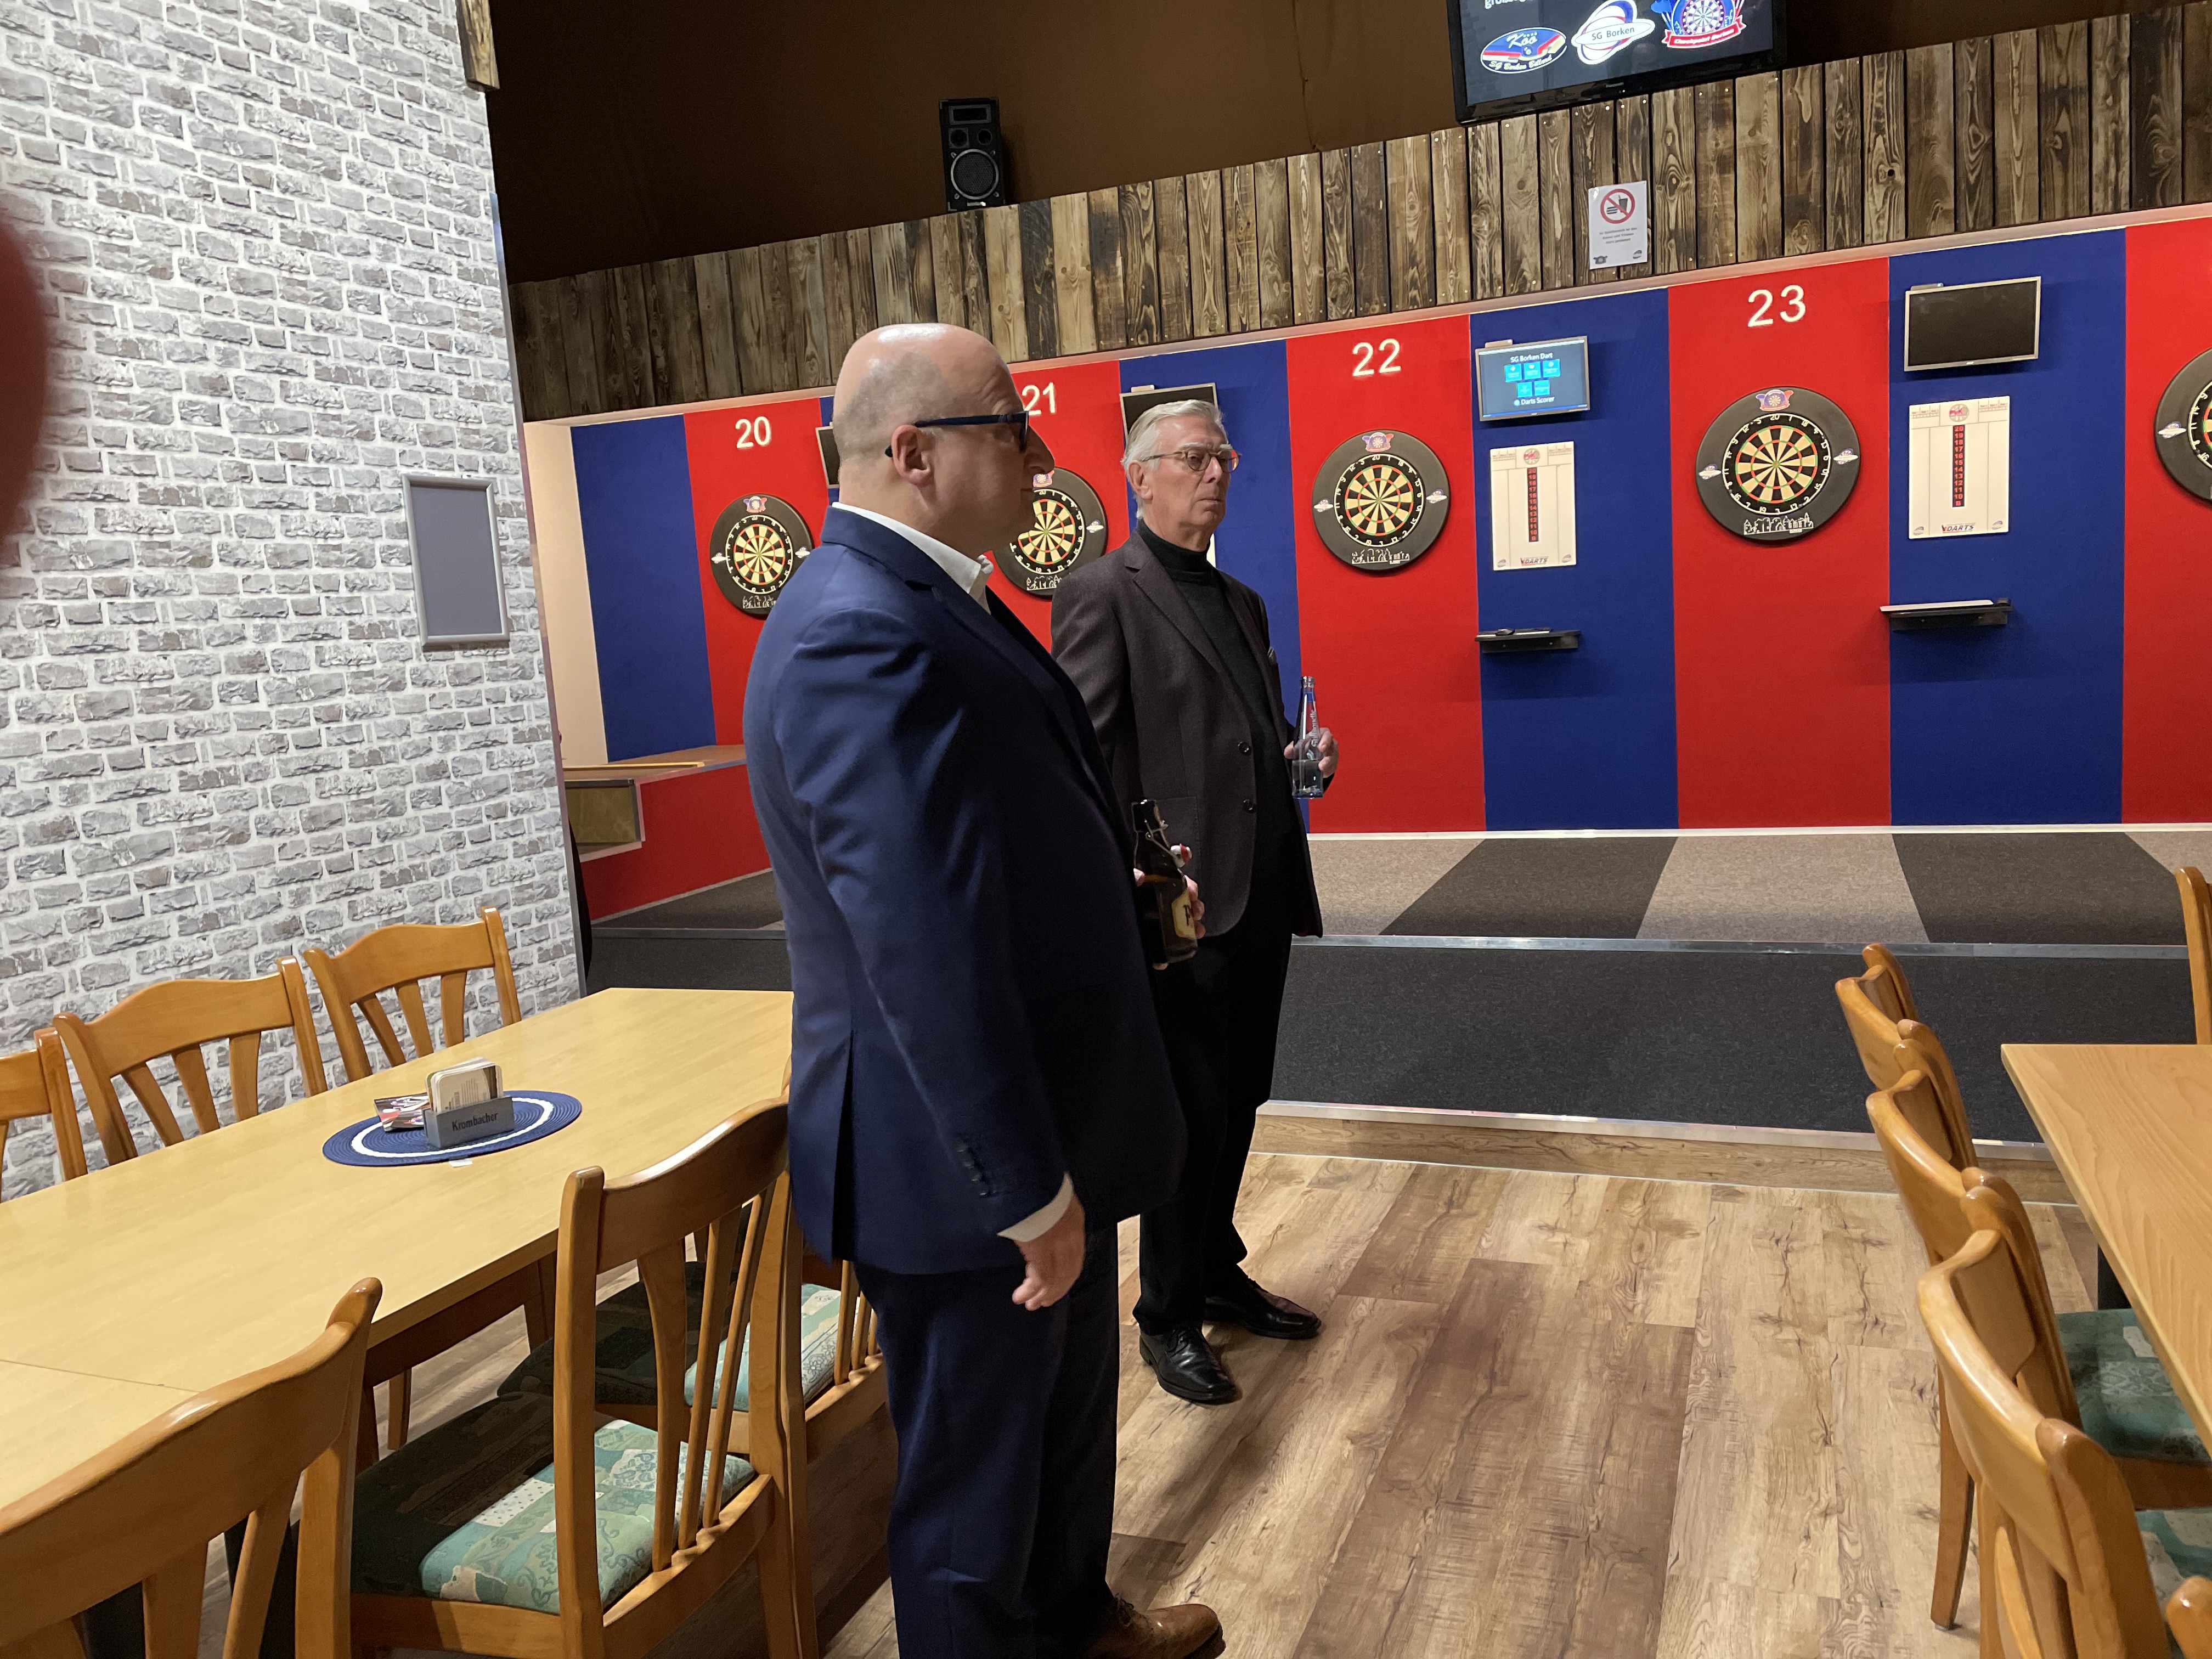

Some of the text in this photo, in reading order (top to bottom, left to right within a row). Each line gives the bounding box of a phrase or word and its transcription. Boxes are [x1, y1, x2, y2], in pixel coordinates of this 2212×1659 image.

[1592, 27, 1634, 41] SG Borken
[1747, 284, 1806, 327] 23
[1352, 338, 1402, 377] 22
[1022, 382, 1056, 416] 21
[735, 416, 771, 449] 20
[1734, 493, 1742, 501] 16
[1742, 425, 1750, 433] 12
[452, 1113, 498, 1131] Krombacher
